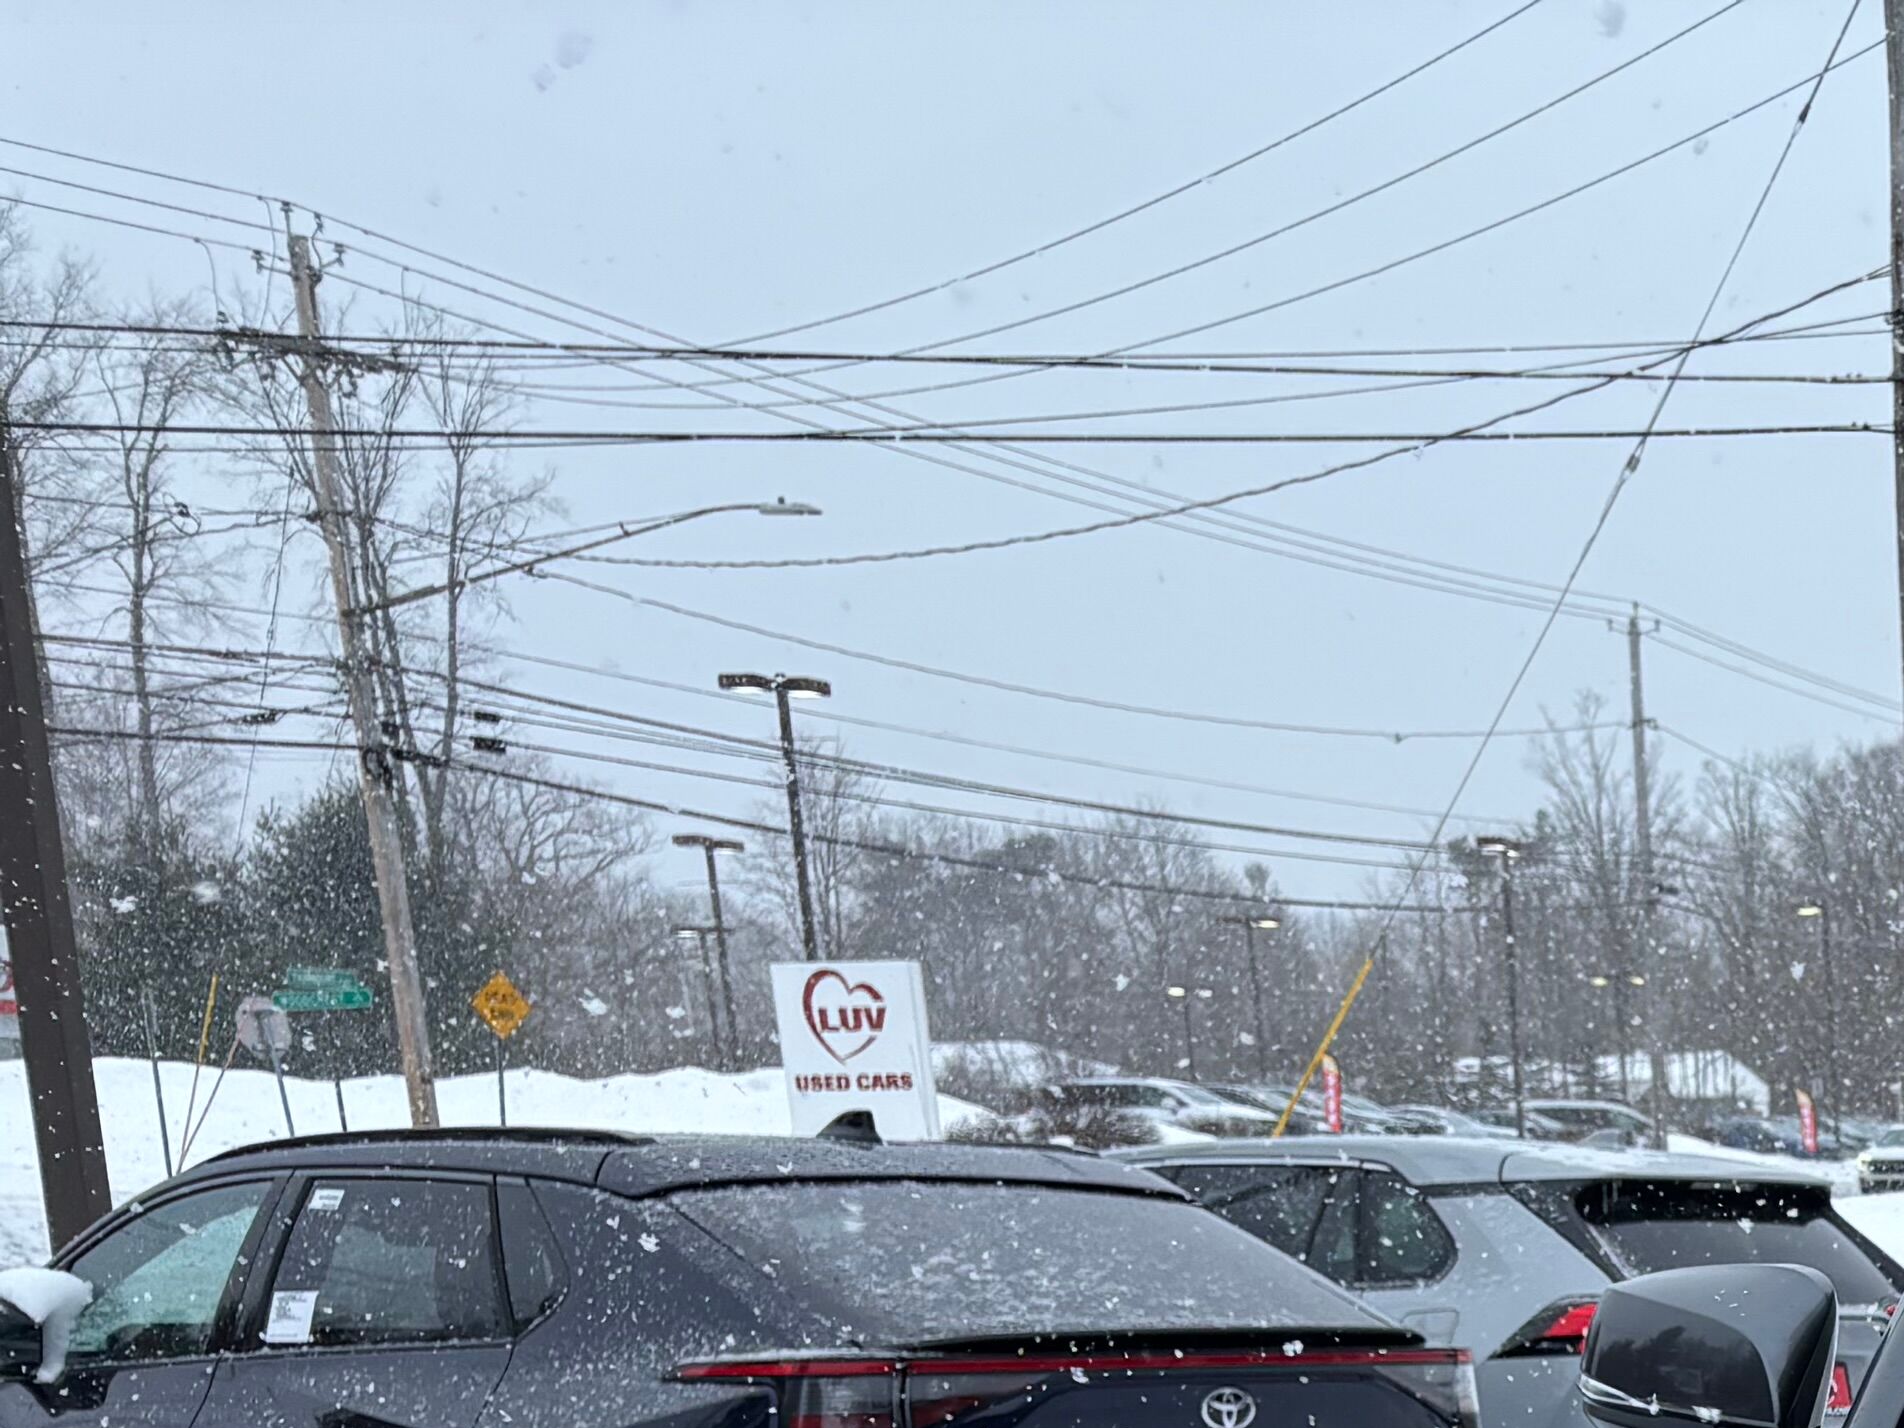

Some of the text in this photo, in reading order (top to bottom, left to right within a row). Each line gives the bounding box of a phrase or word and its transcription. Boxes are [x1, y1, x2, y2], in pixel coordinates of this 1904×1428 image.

[818, 1006, 886, 1032] LUV
[795, 1072, 913, 1091] USED CARS
